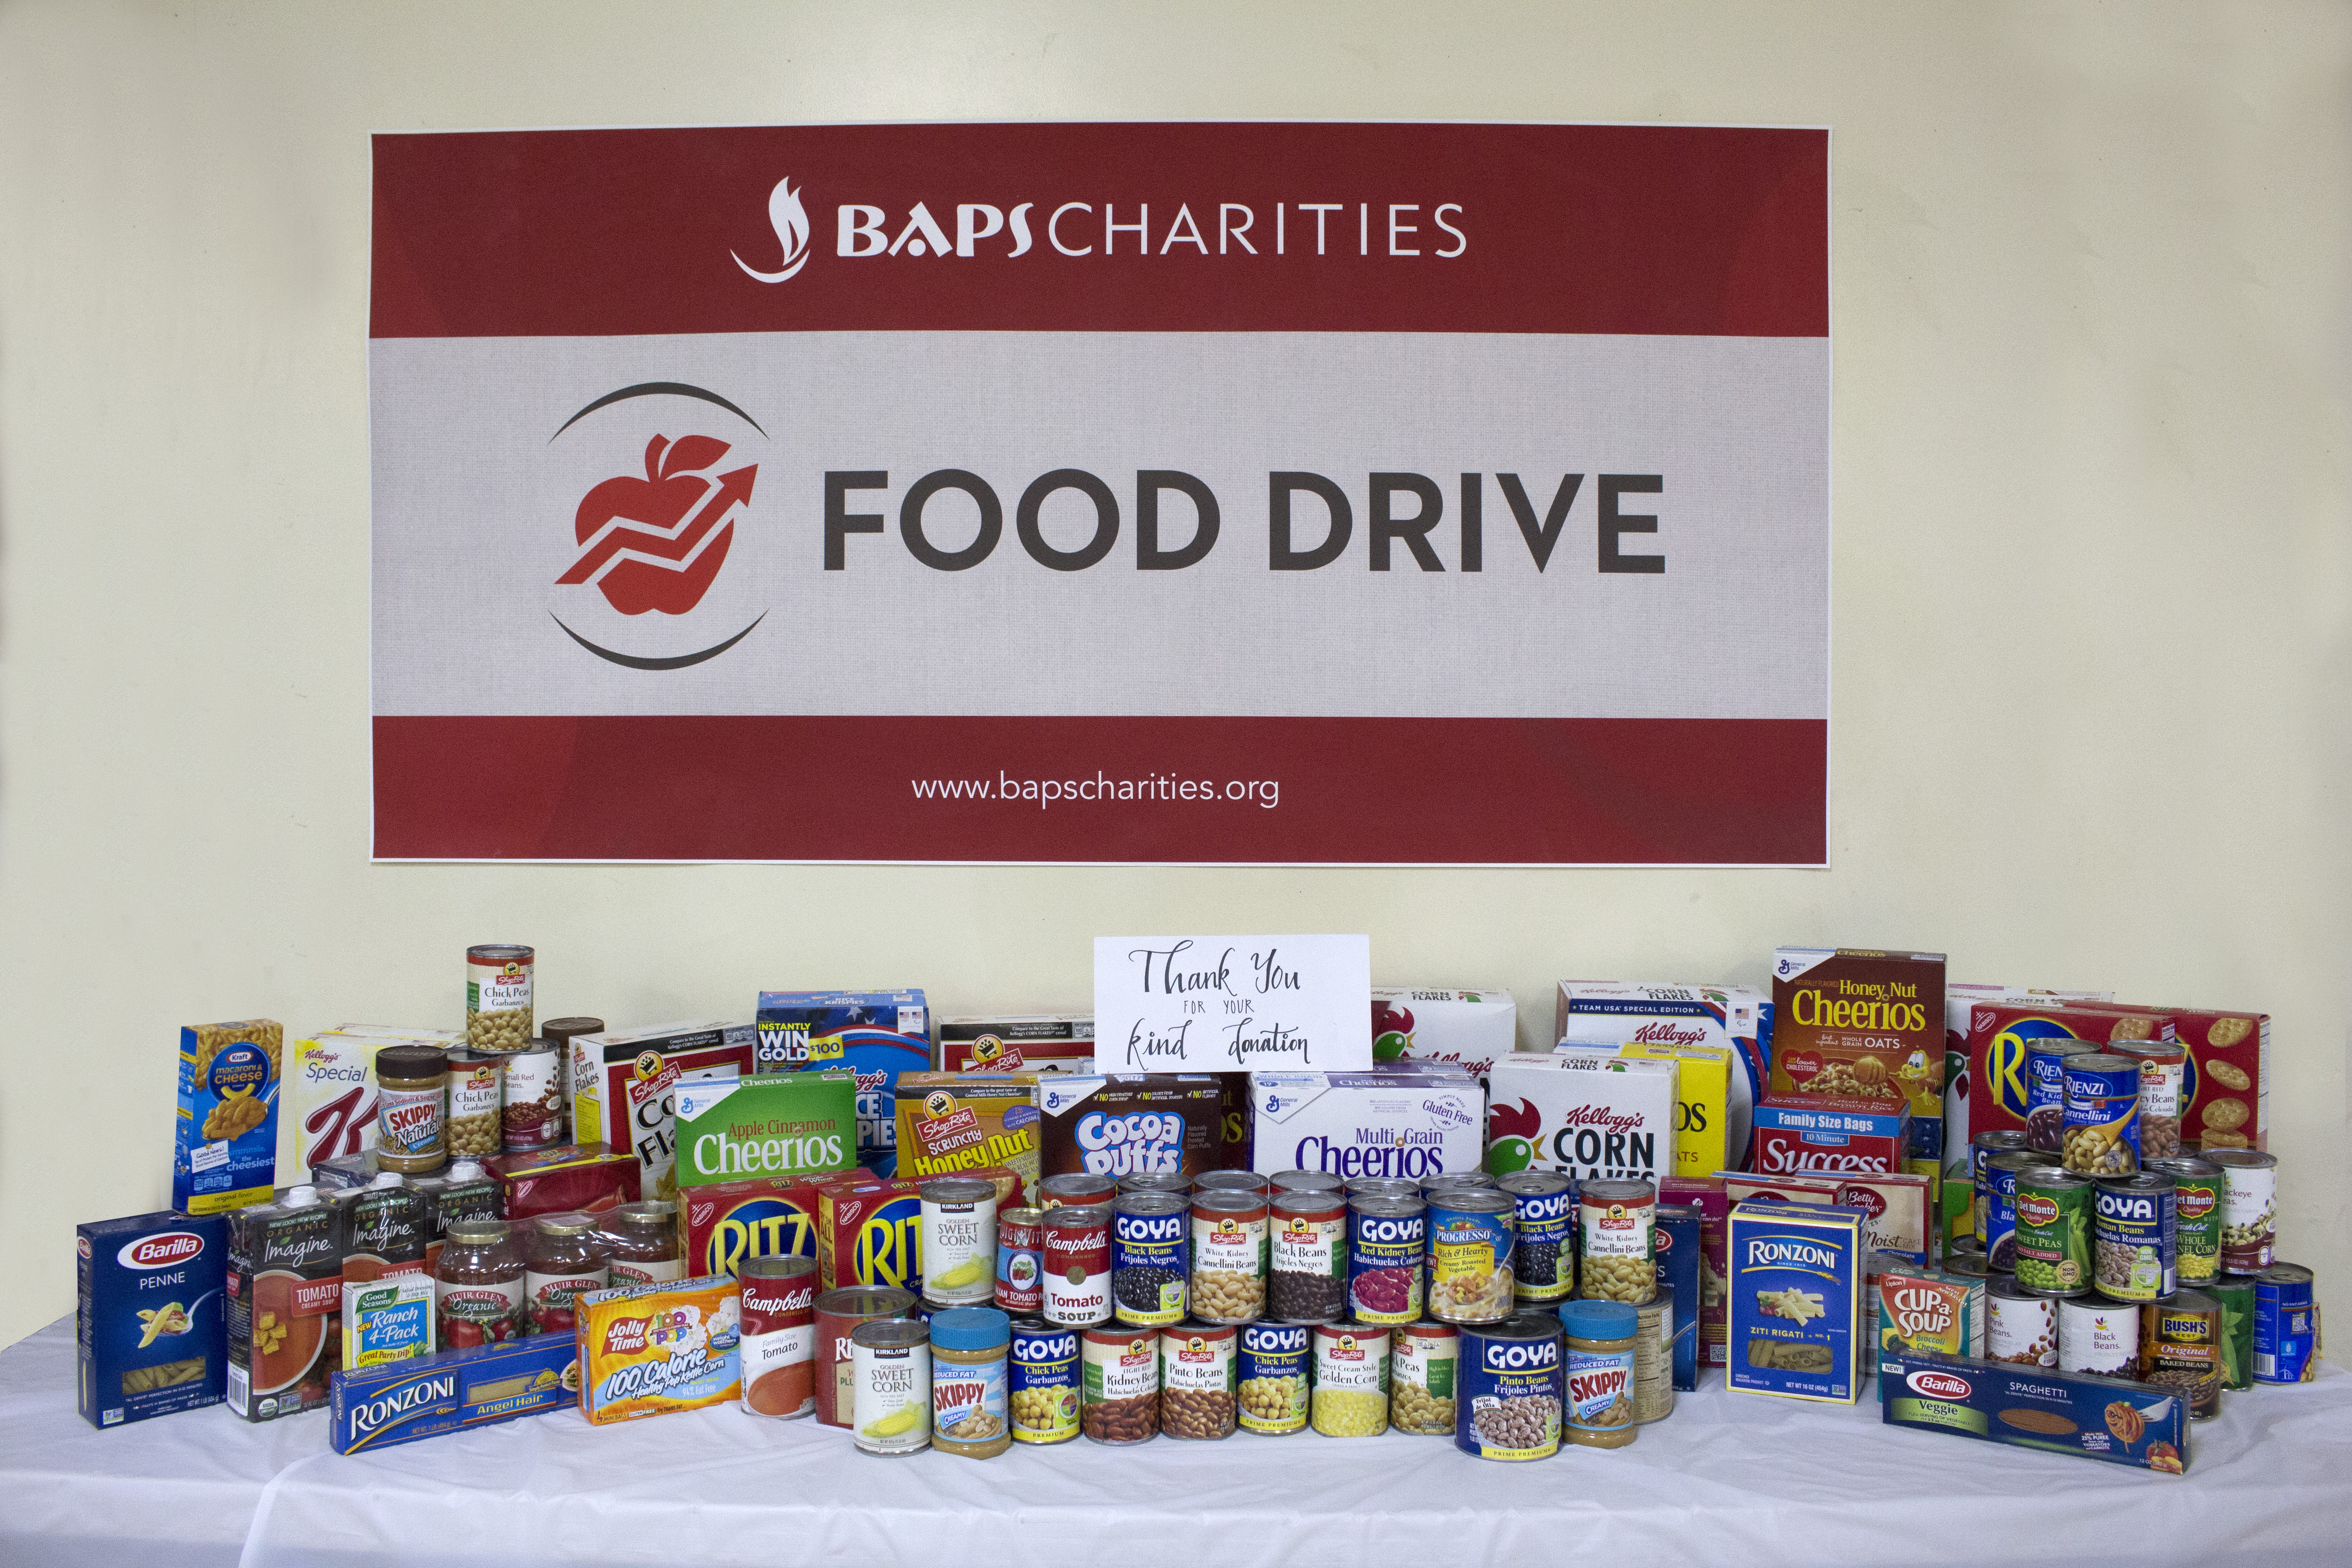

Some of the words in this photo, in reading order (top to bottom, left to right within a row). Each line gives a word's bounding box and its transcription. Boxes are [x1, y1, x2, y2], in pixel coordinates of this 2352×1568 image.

[837, 201, 1035, 259] BAPS
[1048, 201, 1467, 259] CHARITIES
[823, 467, 1221, 573] FOOD
[1269, 471, 1666, 575] DRIVE
[911, 770, 1279, 809] www.bapscharities.org
[1129, 940, 1237, 996] Thank
[1251, 949, 1300, 994] You
[485, 987, 511, 998] Chick
[514, 987, 529, 997] Peas
[1839, 979, 1885, 999] Honey
[1890, 982, 1917, 998] Nut
[1184, 1000, 1205, 1014] FOR
[1224, 999, 1254, 1014] YOUR
[1792, 989, 1926, 1032] Cheerios
[758, 1022, 812, 1031] INSTANTLY
[1634, 1021, 1707, 1046] Kellogg's
[758, 1030, 809, 1048] WIN
[1223, 1018, 1311, 1064] donation
[1865, 1037, 1900, 1049] OATS
[305, 1049, 340, 1063] Kellogg's
[758, 1048, 810, 1061] GOLD
[216, 1065, 256, 1074] macaroni
[306, 1063, 368, 1083] Special
[575, 1061, 594, 1076] Corn
[575, 1073, 600, 1092] Flakes
[2064, 1076, 2104, 1098] RIENZI
[456, 1092, 482, 1102] Chick
[2151, 1094, 2175, 1103] Beans
[389, 1104, 437, 1132] SKIPPY
[1423, 1100, 1452, 1119] Gluten
[1454, 1110, 1473, 1125] Free
[1566, 1104, 1645, 1134] Kellogg's
[1778, 1112, 1816, 1130] Family
[1818, 1114, 1841, 1129] Size
[1844, 1116, 1873, 1132] Bags
[396, 1116, 440, 1148] Natural
[728, 1122, 764, 1141] Apple
[1355, 1128, 1395, 1145] Multi
[1404, 1128, 1443, 1145] Grain
[1816, 1133, 1845, 1143] Minute
[693, 1132, 843, 1176] Cheerios
[1553, 1127, 1654, 1169] CORN
[227, 1157, 274, 1171] cheesiest
[1294, 1135, 1443, 1179] Cheerios
[1847, 1191, 1875, 1209] Betty
[2187, 1196, 2213, 1205] Monte
[2029, 1205, 2056, 1215] Monte
[267, 1221, 328, 1238] ORGANIC
[938, 1222, 979, 1235] SWEET
[1117, 1217, 1181, 1240] GOYA
[1362, 1218, 1424, 1241] GOYA
[1520, 1223, 1543, 1233] Black
[1544, 1221, 1565, 1231] Beans
[2119, 1225, 2144, 1234] Beans
[939, 1233, 978, 1246] CORN
[1046, 1230, 1106, 1257] Campbell's
[1436, 1230, 1490, 1243] PROGRESSO
[1595, 1233, 1614, 1242] White
[2038, 1236, 2062, 1248] PEAS
[137, 1238, 197, 1260] Barilla
[265, 1236, 331, 1267] Imagine
[1124, 1245, 1147, 1255] Black
[1148, 1246, 1173, 1255] Beans
[1205, 1247, 1225, 1258] White
[1274, 1241, 1296, 1258] Black
[1298, 1246, 1327, 1258] Beans
[1361, 1245, 1376, 1254] Red
[1377, 1246, 1406, 1256] Kidney
[1438, 1248, 1453, 1257] Rich
[1463, 1247, 1488, 1257] Hearty
[1588, 1241, 1624, 1253] Cannellini
[1625, 1244, 1646, 1254] Beans
[1748, 1240, 1836, 1269] RONZONI
[1236, 1259, 1257, 1269] Beans
[140, 1272, 185, 1289] PENNE
[1885, 1279, 1903, 1288] Lipton
[297, 1284, 339, 1303] TOMATO
[366, 1292, 387, 1301] Good
[448, 1292, 473, 1303] MUIR
[474, 1291, 503, 1302] GLEN
[1010, 1292, 1037, 1301] TOMATO
[1050, 1292, 1103, 1308] Tomato
[302, 1301, 321, 1309] CREAMY
[363, 1299, 392, 1308] Seasons
[743, 1287, 813, 1317] Campbell's
[371, 1308, 418, 1327] Ranch
[1058, 1311, 1096, 1321] SOUP
[357, 1321, 372, 1333] NEW
[608, 1320, 645, 1338] Jolly
[1897, 1311, 1951, 1337] SOUP
[2164, 1318, 2207, 1334] BUSH'S
[368, 1324, 419, 1344] 4-Pack
[1245, 1327, 1307, 1350] GOYA
[1750, 1326, 1769, 1336] ZITI
[1772, 1328, 1804, 1339] RIGATI
[1916, 1334, 1946, 1345] Broccoli
[2093, 1332, 2117, 1341] Black
[609, 1337, 644, 1352] Time
[762, 1342, 798, 1360] Tomato
[1013, 1335, 1076, 1361] GOYA
[2093, 1341, 2119, 1350] Beans
[2160, 1344, 2210, 1356] Original
[358, 1351, 377, 1363] Great
[1254, 1356, 1279, 1366] Chick
[1281, 1356, 1298, 1365] Peas
[1487, 1343, 1557, 1368] GOYA
[606, 1367, 643, 1400] 100
[644, 1348, 707, 1382] Calorie
[871, 1367, 914, 1381] SWEET
[1025, 1366, 1050, 1375] Chick
[1051, 1364, 1068, 1373] Peas
[1170, 1364, 1193, 1377] Pinto
[1196, 1367, 1223, 1379] Beans
[1254, 1364, 1298, 1375] Garbanzos
[1885, 1364, 1901, 1373] NEW!
[1025, 1374, 1068, 1385] Garbanzos
[1107, 1372, 1141, 1390] Kidney
[1319, 1371, 1352, 1384] Golden
[1354, 1372, 1377, 1384] Corn
[1499, 1375, 1524, 1386] Pinto
[1525, 1375, 1549, 1384] Beans
[1921, 1376, 1966, 1394] Barilla
[872, 1379, 913, 1392] CORN
[1494, 1384, 1529, 1396] Frijoles
[1569, 1370, 1627, 1402] SKIPPY
[2010, 1382, 2067, 1398] SPAGHETTI
[477, 1400, 514, 1415] Angel
[516, 1393, 543, 1407] Hair
[934, 1383, 985, 1411] SKIPPY
[351, 1376, 454, 1441] RONZONI
[1919, 1400, 1958, 1416] Veggie
